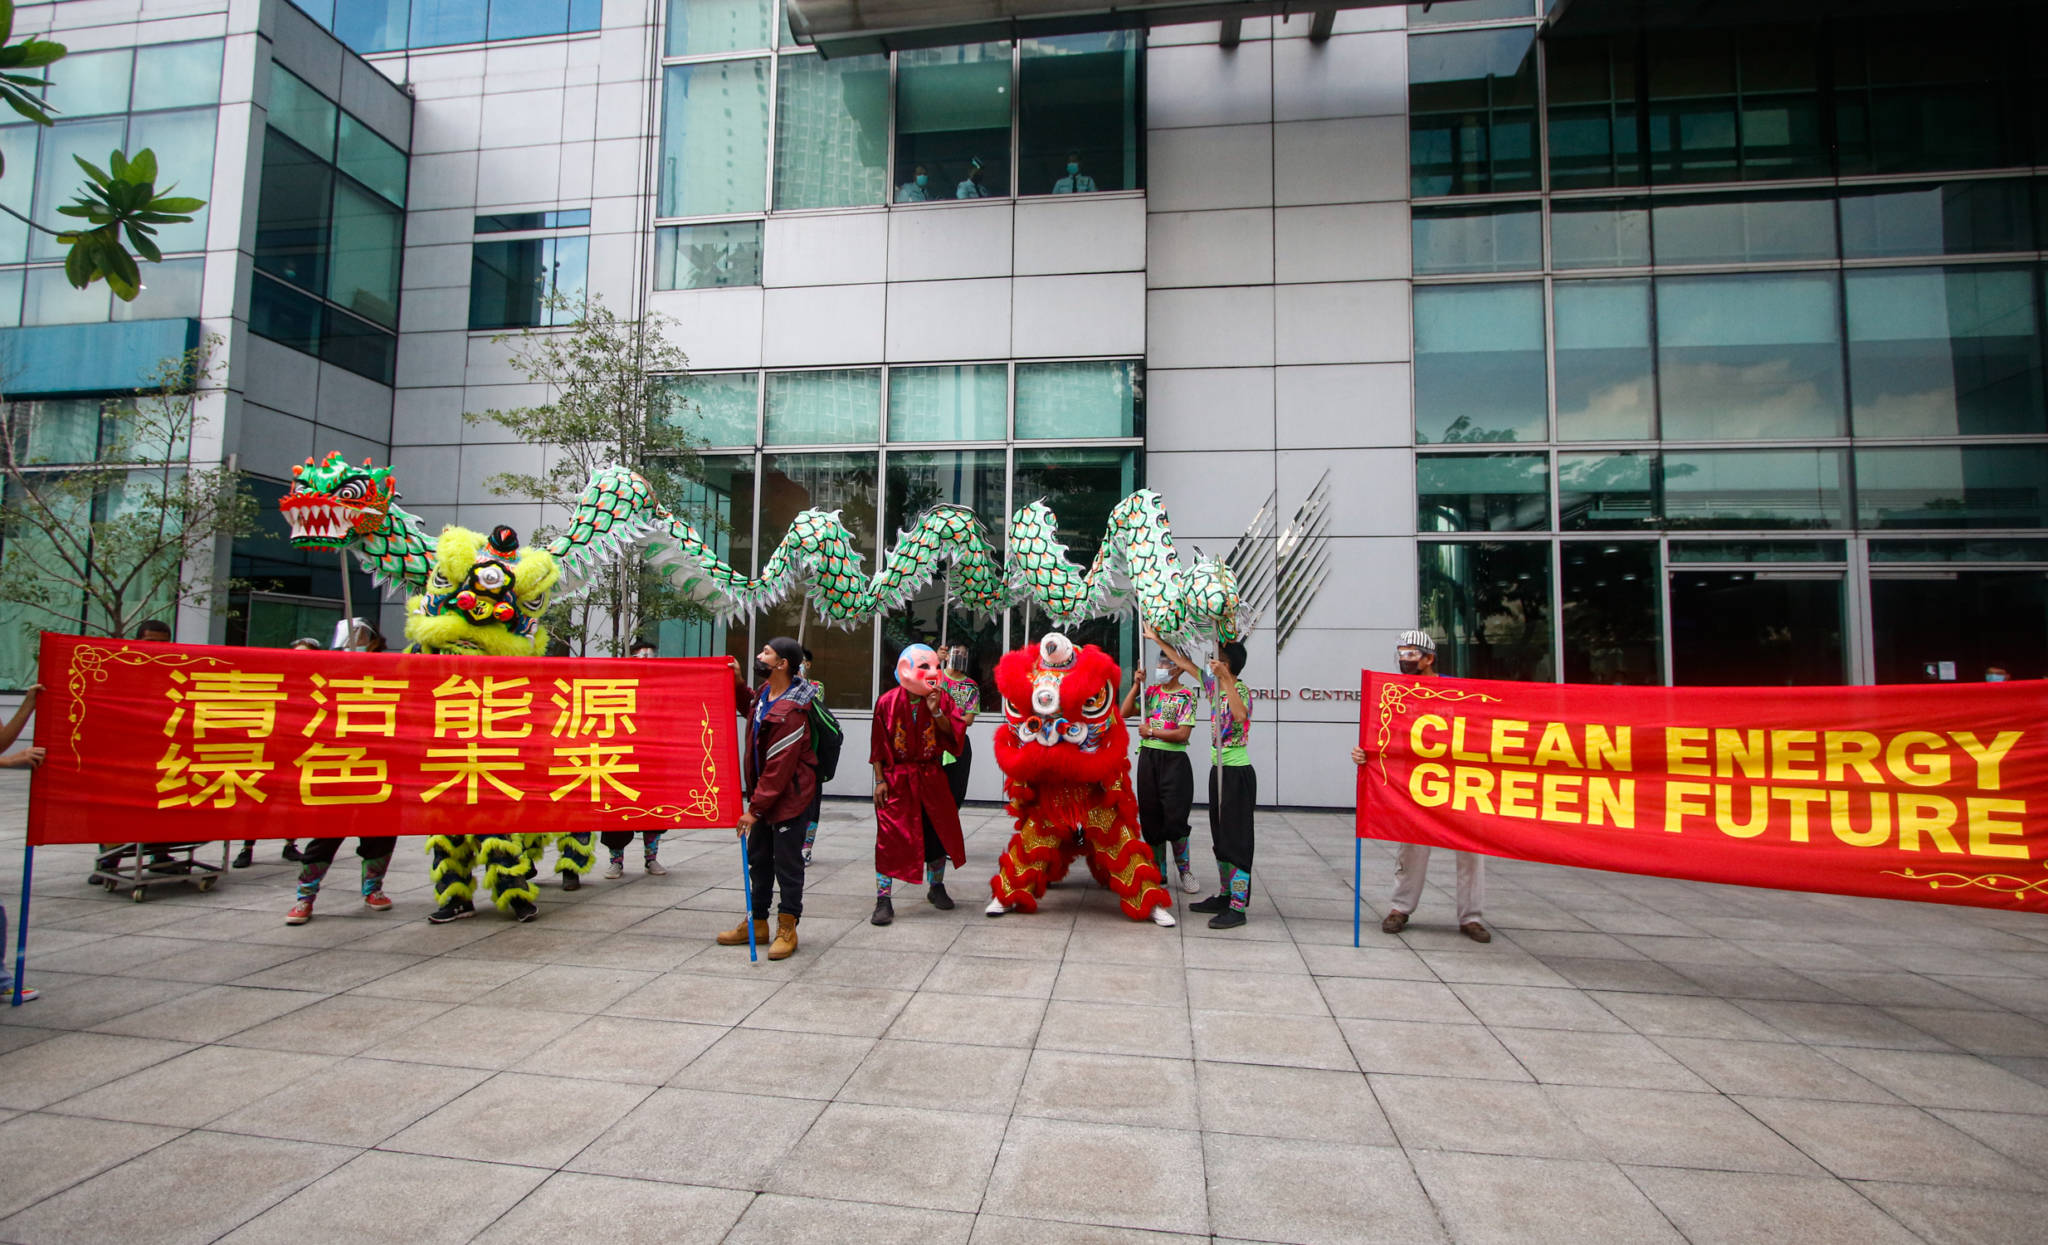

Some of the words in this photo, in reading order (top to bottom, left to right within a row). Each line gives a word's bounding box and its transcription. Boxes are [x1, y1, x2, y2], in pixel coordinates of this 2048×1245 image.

[163, 670, 640, 740] 清洁能源
[1250, 689, 1291, 701] ORLD
[155, 742, 642, 809] 绿色未来
[1410, 714, 1633, 772] CLEAN
[1665, 726, 2024, 791] ENERGY
[1408, 762, 1636, 829] GREEN
[1664, 781, 2031, 860] FUTURE
